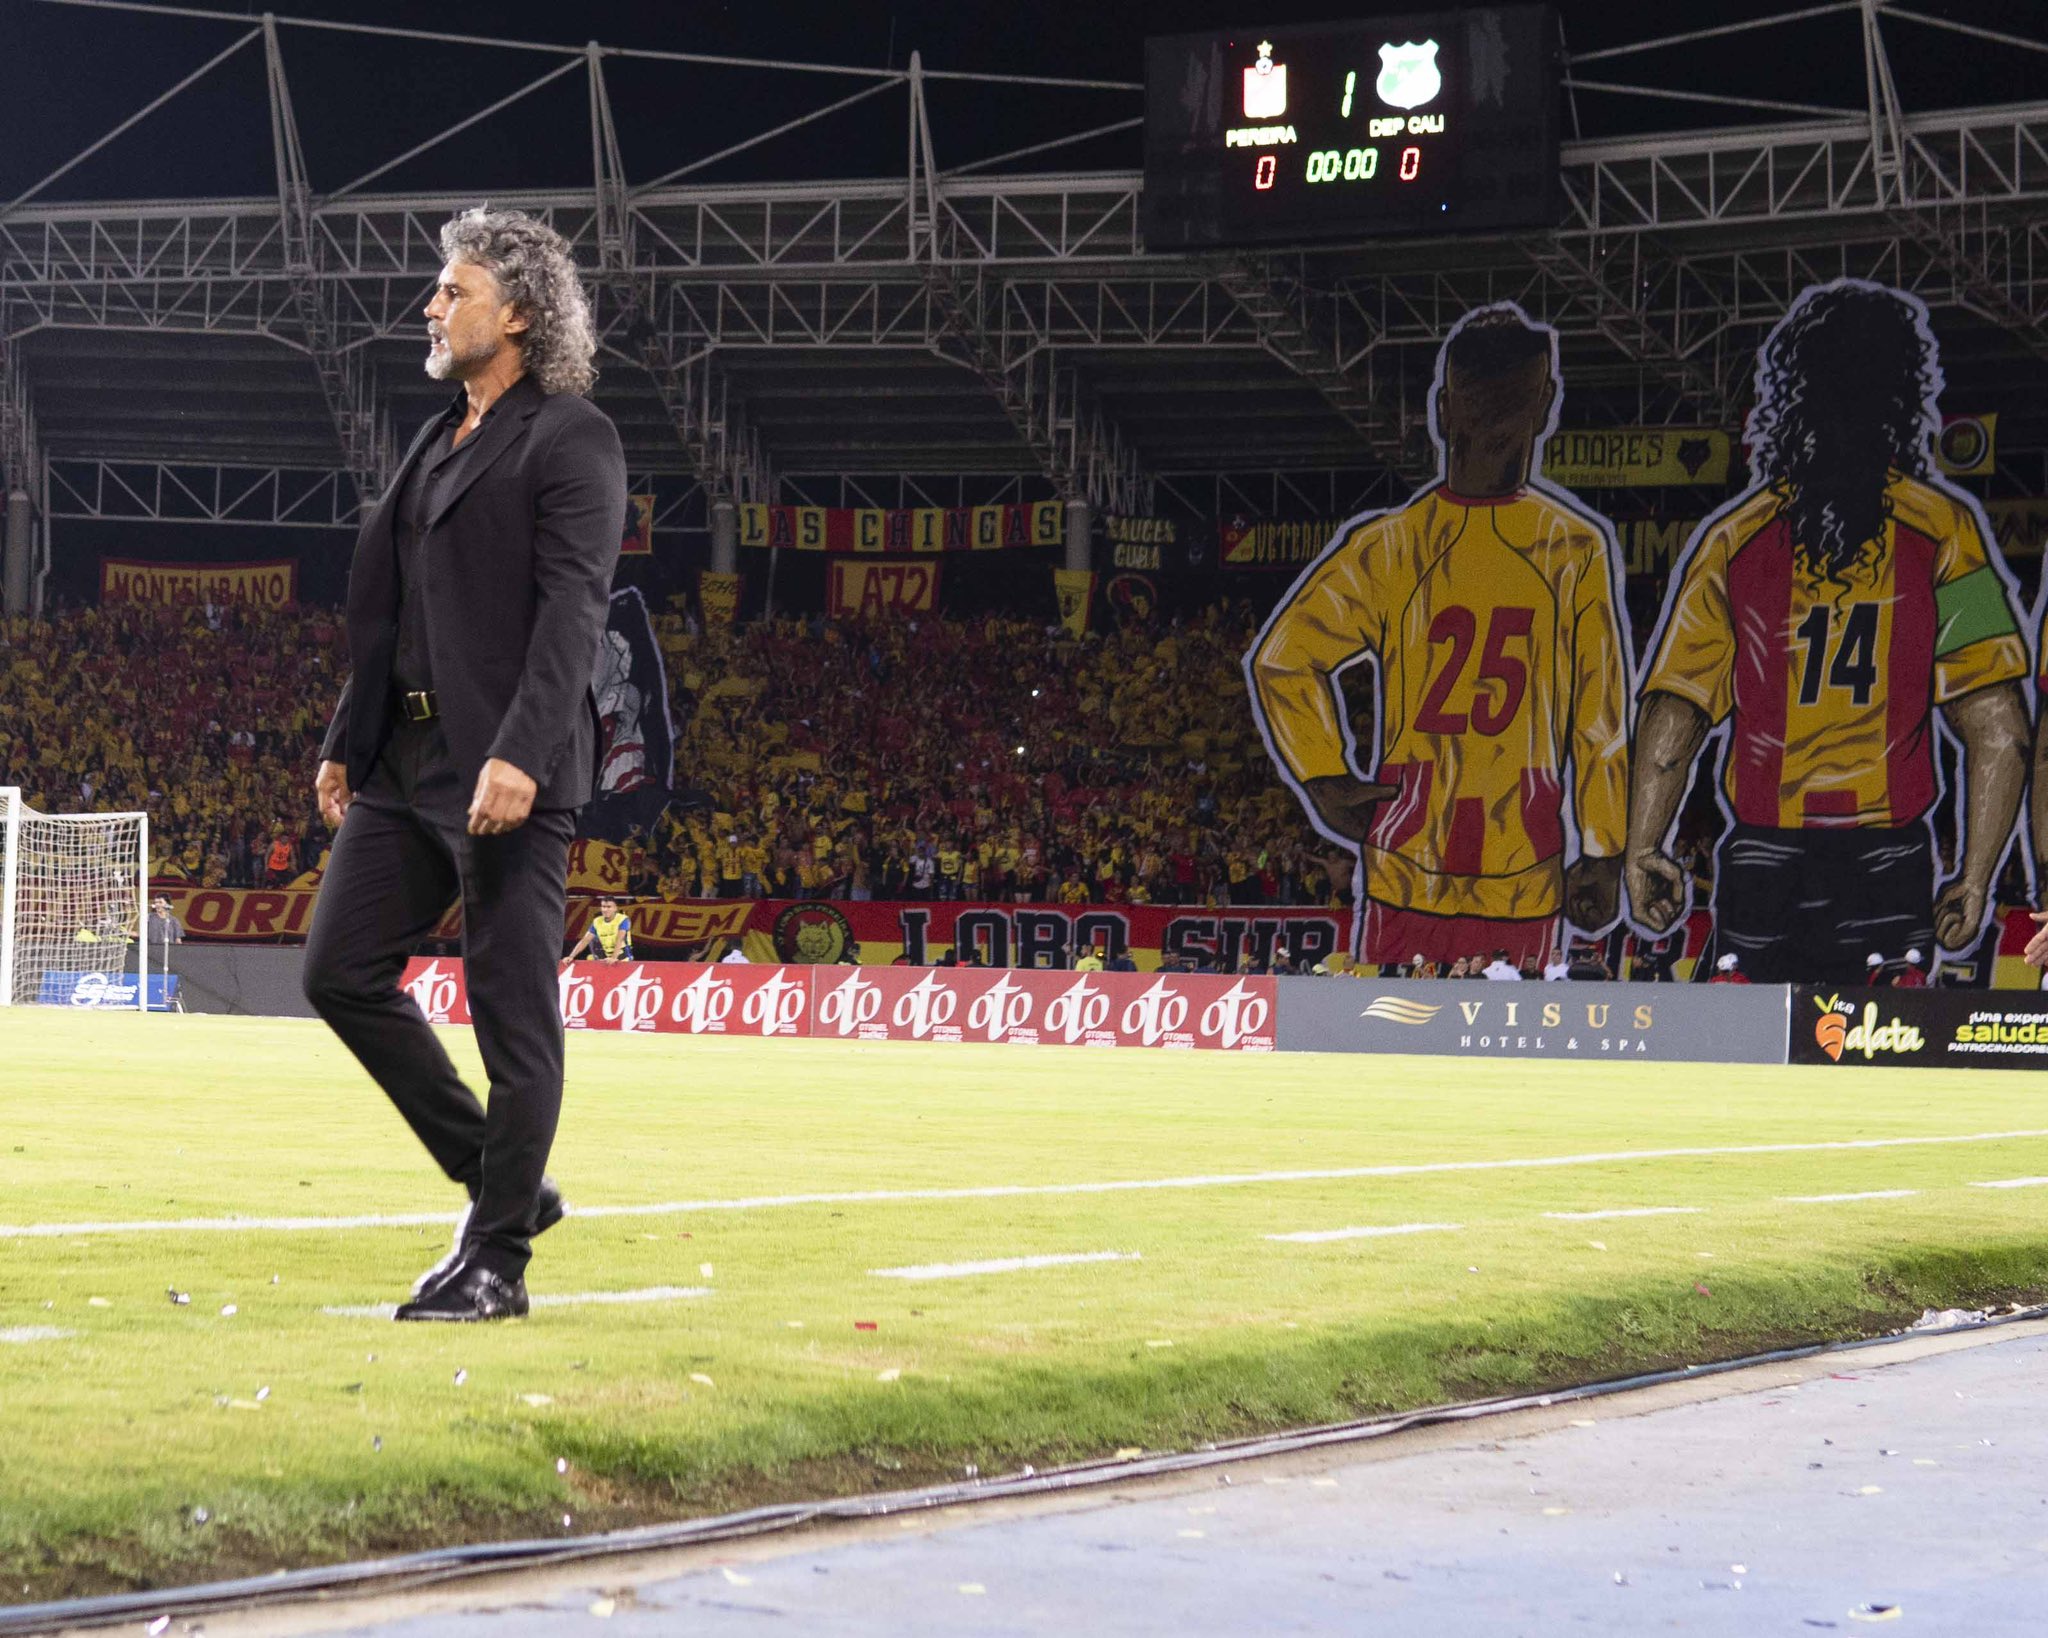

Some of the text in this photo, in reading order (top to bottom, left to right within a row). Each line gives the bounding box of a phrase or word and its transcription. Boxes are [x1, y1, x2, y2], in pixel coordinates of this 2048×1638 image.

[1226, 125, 1297, 147] PEREIRA
[1369, 114, 1444, 137] DEP CALI
[1255, 155, 1276, 189] 0
[1306, 148, 1378, 182] 00:00
[1400, 147, 1420, 180] 0
[746, 505, 1056, 548] LAS CHINGAS
[1413, 605, 1536, 737] 25
[1796, 602, 1880, 708] 14
[900, 907, 1131, 970] LOBO
[1458, 1001, 1653, 1030] VISUS
[1813, 993, 1855, 1015] Vita
[1460, 1035, 1647, 1052] HOTEL & SPA
[1955, 1022, 2048, 1043] saluda
